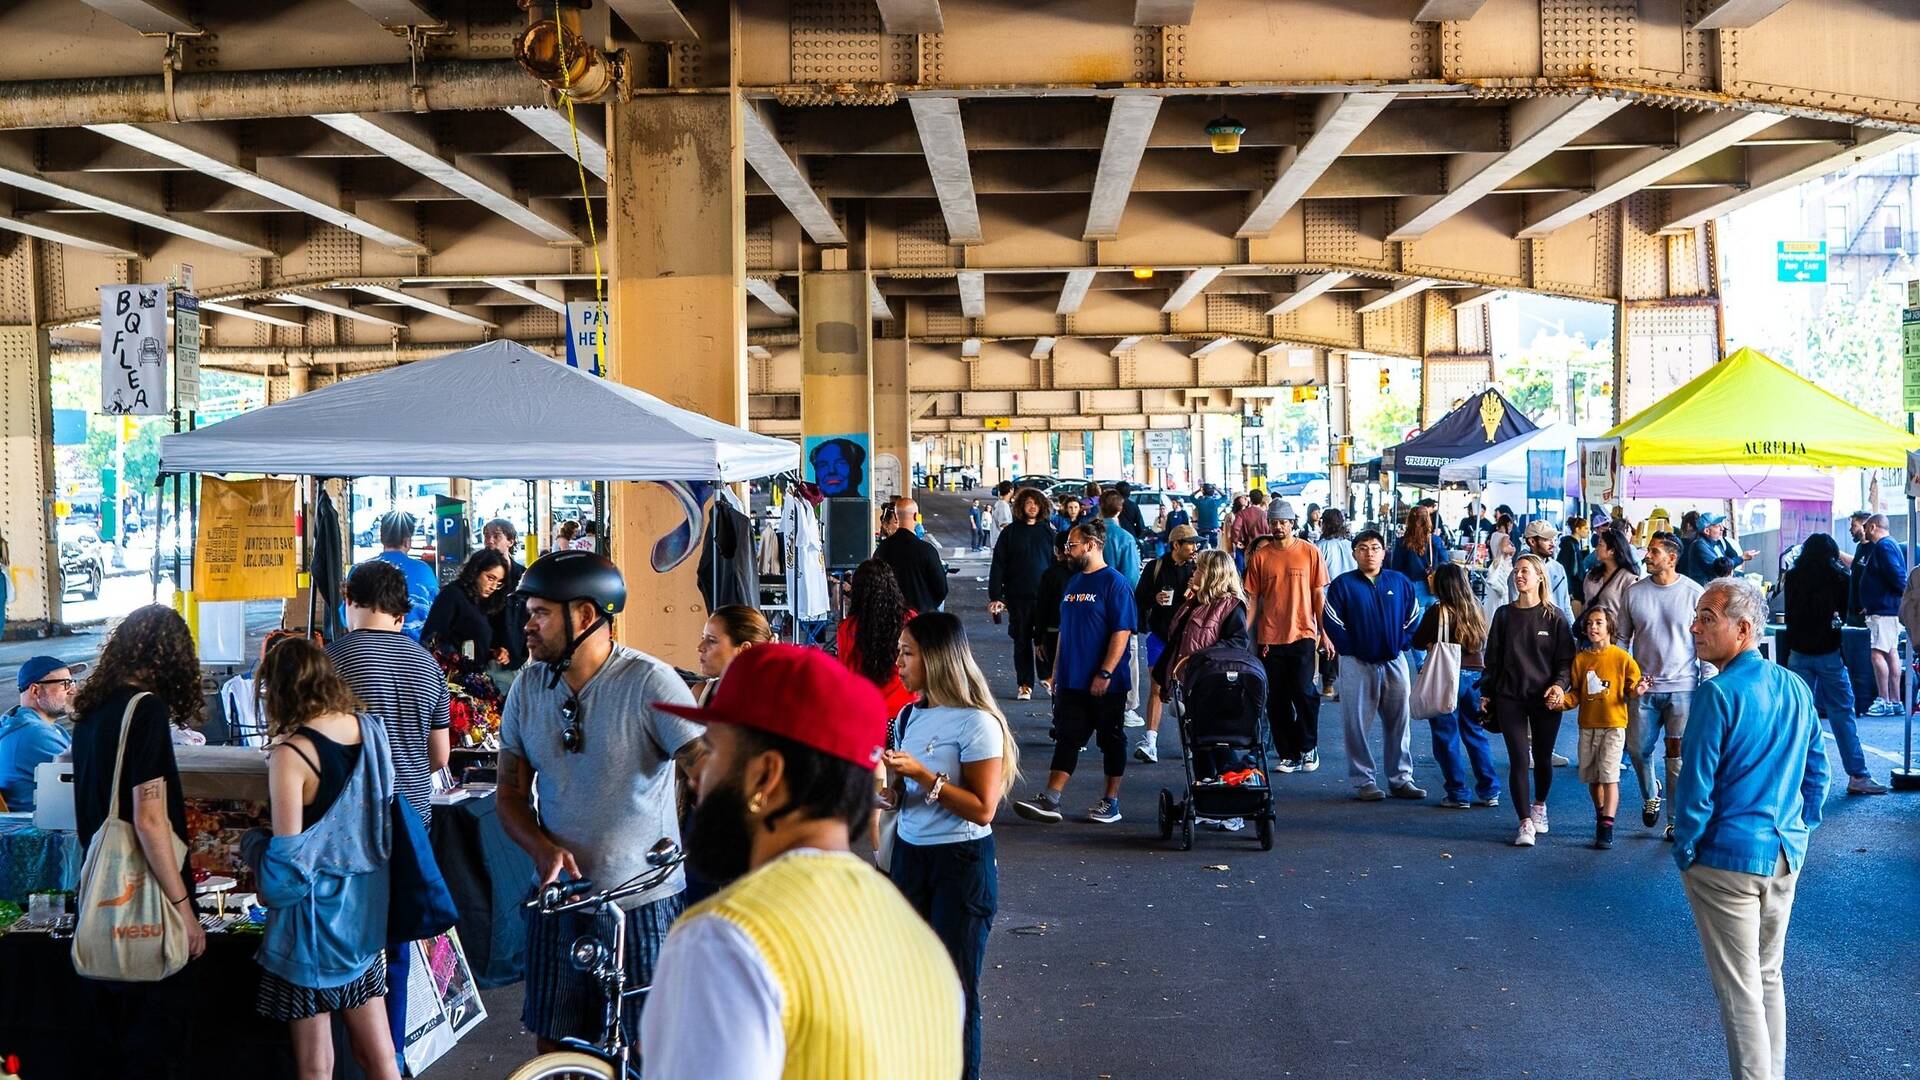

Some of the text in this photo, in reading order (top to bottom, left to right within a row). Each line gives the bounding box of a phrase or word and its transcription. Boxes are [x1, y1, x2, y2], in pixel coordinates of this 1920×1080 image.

[583, 310, 608, 325] PAY
[579, 331, 607, 346] HER
[1743, 441, 1806, 454] AURELIA
[444, 518, 454, 534] P
[1076, 593, 1096, 602] YORK
